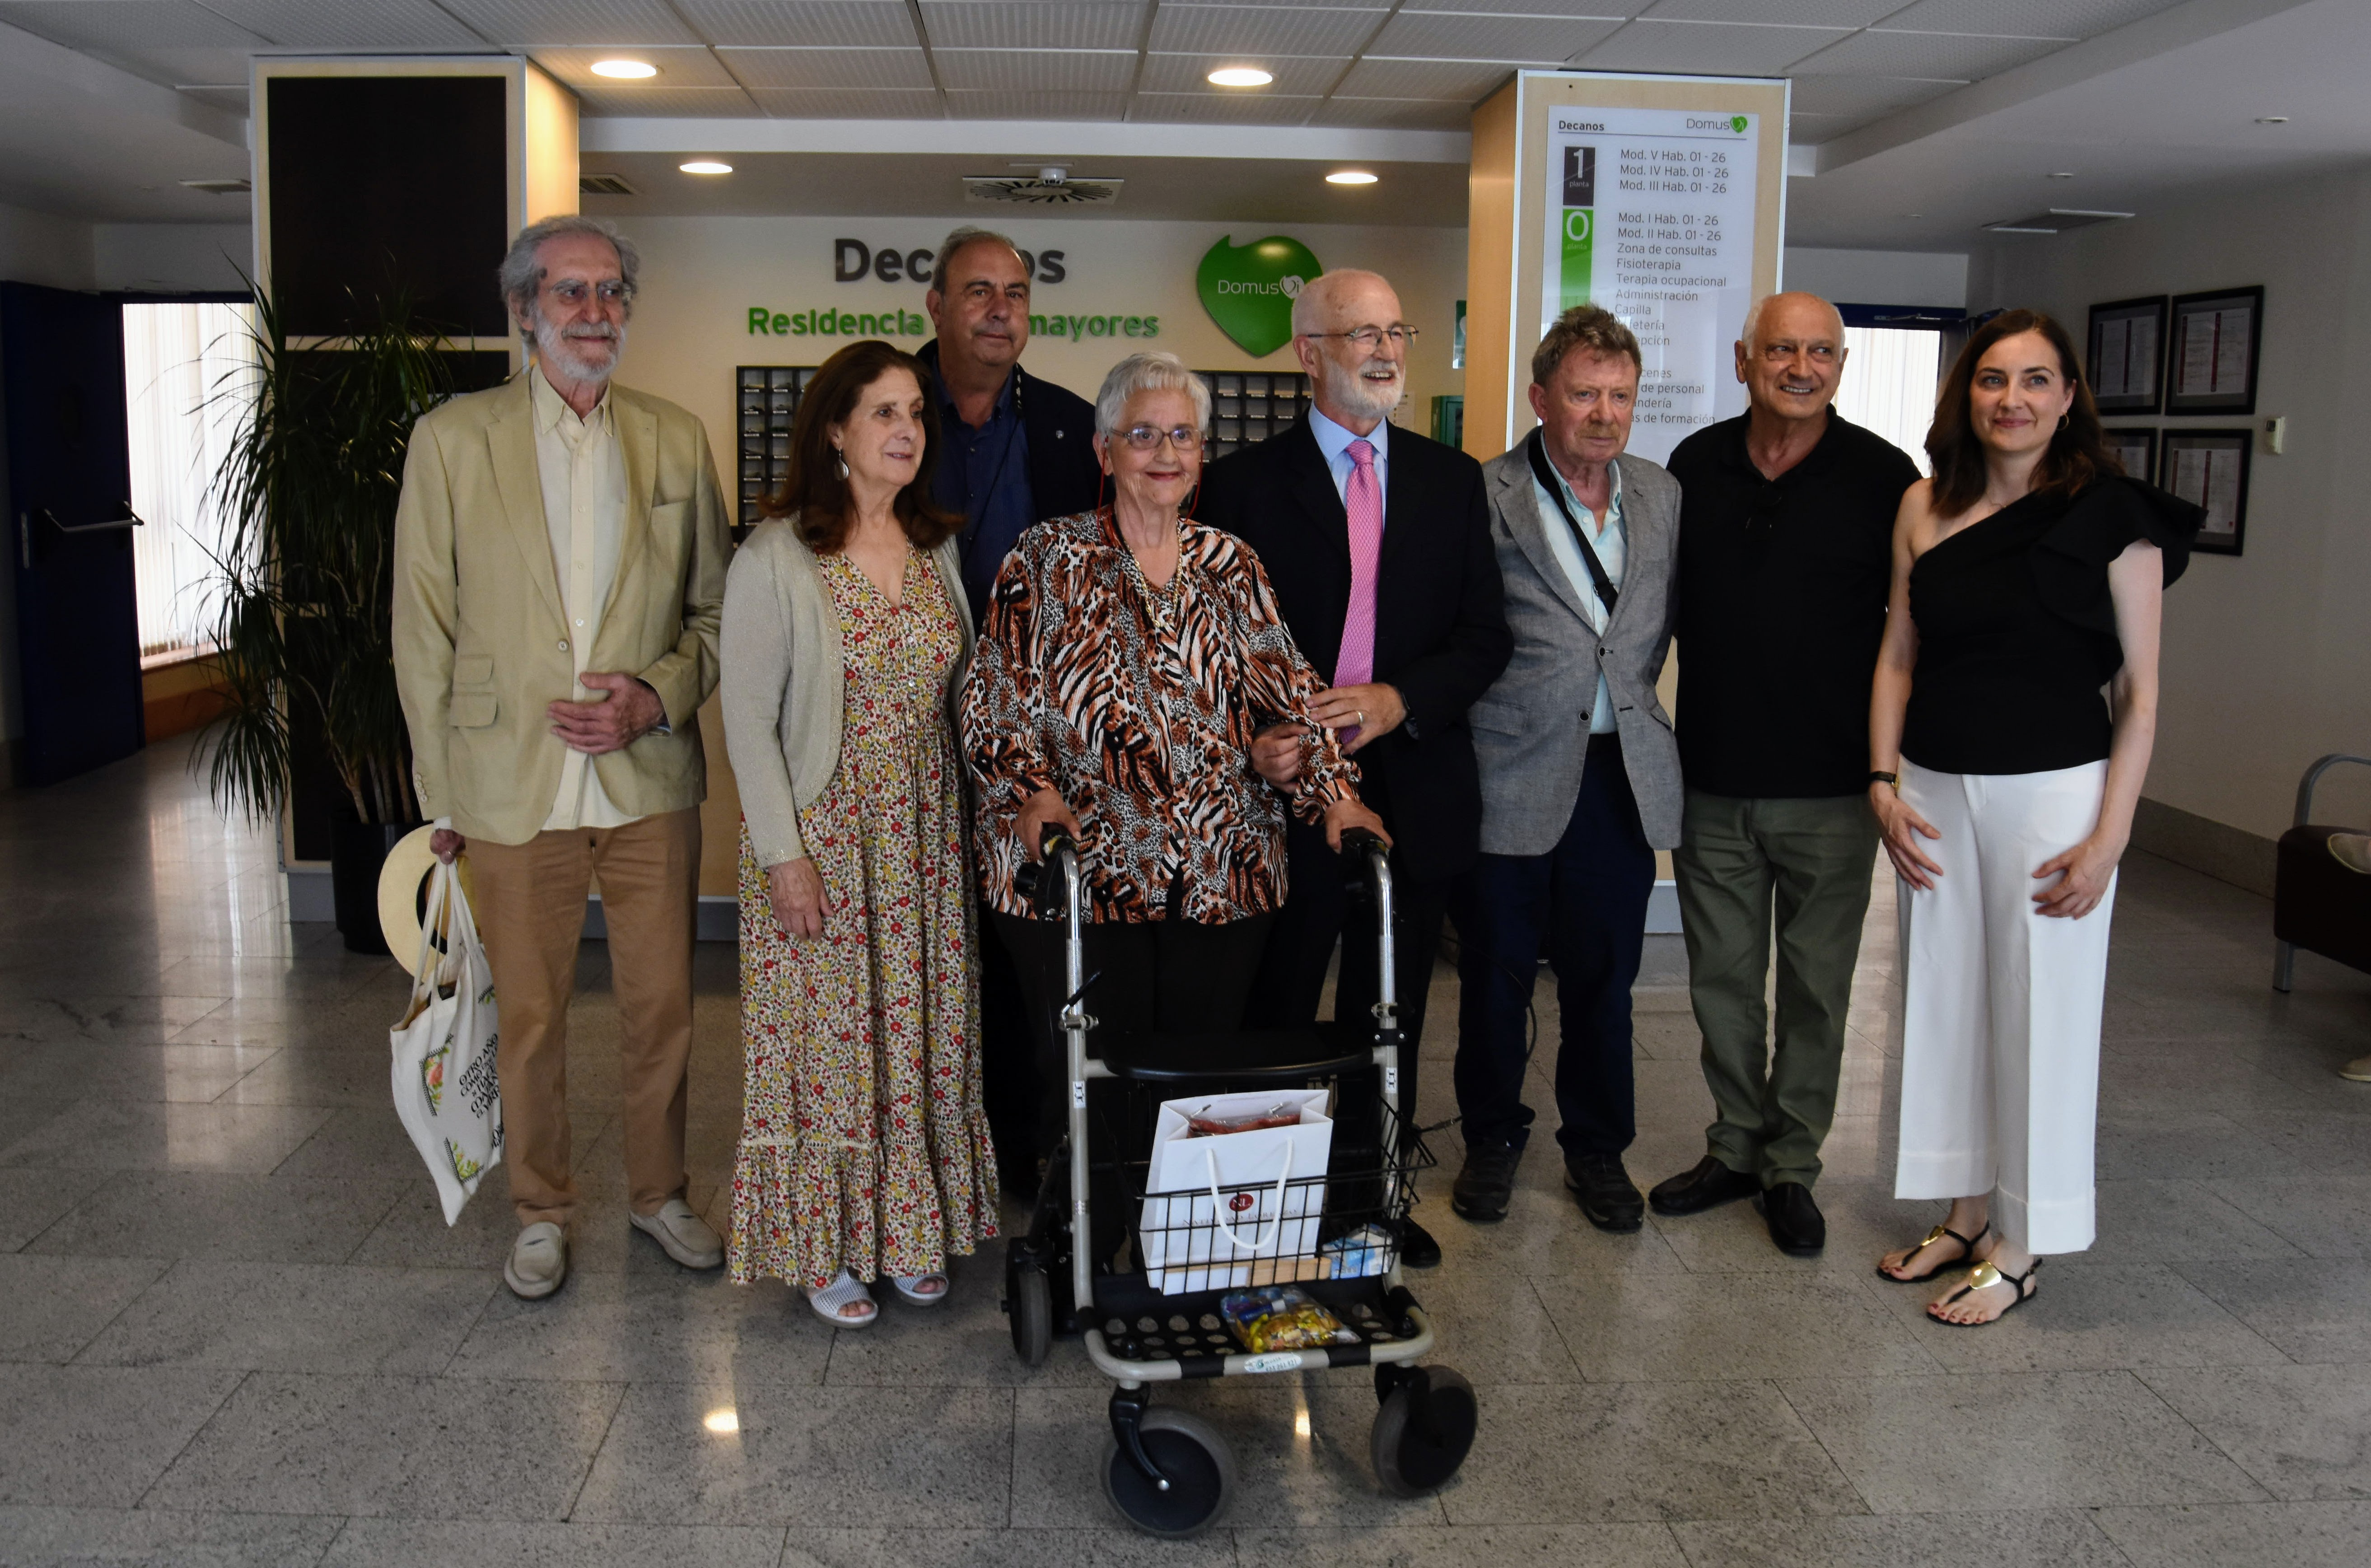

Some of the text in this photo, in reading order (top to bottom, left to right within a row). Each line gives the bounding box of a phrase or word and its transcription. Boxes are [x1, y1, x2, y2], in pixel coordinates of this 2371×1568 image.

[1559, 120, 1605, 131] Decanos
[1621, 149, 1647, 160] Mod.
[1651, 151, 1658, 160] V
[1662, 151, 1686, 161] Hab.
[1690, 151, 1701, 161] 01
[1712, 152, 1726, 162] 26
[1573, 149, 1583, 178] 1
[1620, 165, 1646, 176] Mod.
[1650, 166, 1661, 176] IV
[1665, 166, 1689, 177] Hab.
[1693, 168, 1704, 177] 01
[1714, 168, 1728, 178] 26
[1620, 180, 1646, 191] Mod.
[1650, 181, 1659, 191] III
[1662, 182, 1687, 192] Hab.
[1690, 182, 1702, 192] 01
[1712, 183, 1726, 193] 26
[1566, 211, 1589, 241] 0
[1618, 213, 1644, 223] Mod.
[1648, 214, 1650, 224] I
[1655, 214, 1679, 224] Hab.
[1682, 215, 1694, 225] 01
[1704, 215, 1718, 226] 26
[1618, 228, 1643, 238] Mod.
[1648, 229, 1653, 238] II
[1657, 229, 1681, 240] Hab.
[1685, 230, 1696, 240] 01
[1707, 231, 1721, 241] 26
[1618, 243, 1717, 256] Zona de consultas
[1616, 258, 1680, 271] Fisioterapia
[1616, 273, 1726, 288] Terapia ocupacional
[1615, 289, 1698, 301] Administración
[1615, 304, 1651, 315] Capilla
[748, 307, 1159, 342] Residencia mayores
[1629, 320, 1665, 330] fetería
[1641, 384, 1704, 395] de personal
[1644, 412, 1657, 422] de
[1661, 413, 1715, 424] formación
[460, 1056, 482, 1085] OTRO
[460, 1069, 482, 1097] COMO
